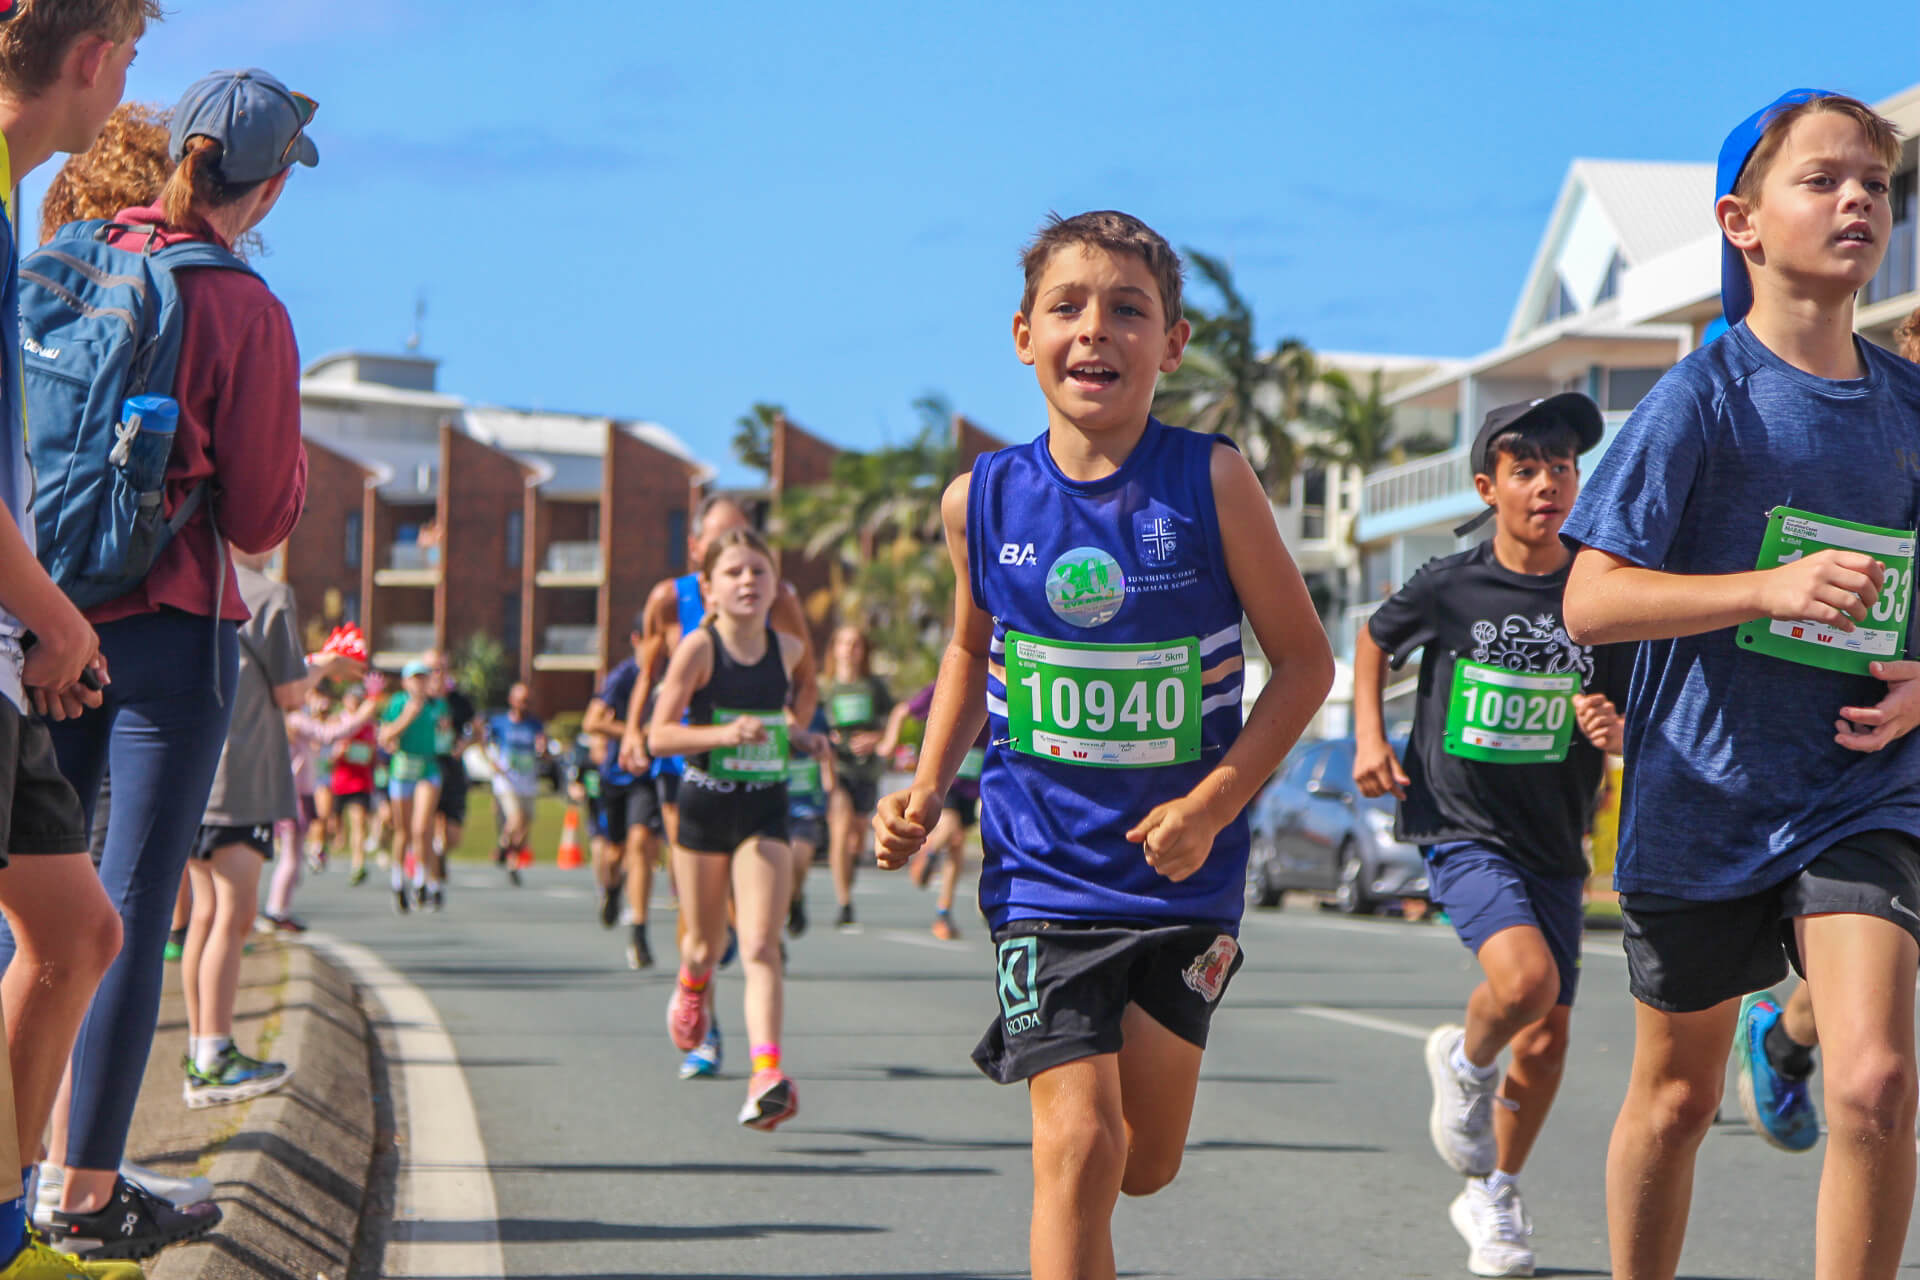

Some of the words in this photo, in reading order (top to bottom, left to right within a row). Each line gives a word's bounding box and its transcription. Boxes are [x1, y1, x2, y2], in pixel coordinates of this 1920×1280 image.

[1125, 583, 1169, 593] GRAMMAR
[1171, 577, 1198, 589] SCHOOL
[1127, 573, 1171, 583] SUNSHINE
[1172, 568, 1197, 579] COAST
[1165, 653, 1184, 662] 5km
[1021, 671, 1185, 733] 10940
[1462, 687, 1567, 731] 10920
[1006, 1012, 1041, 1036] KODA
